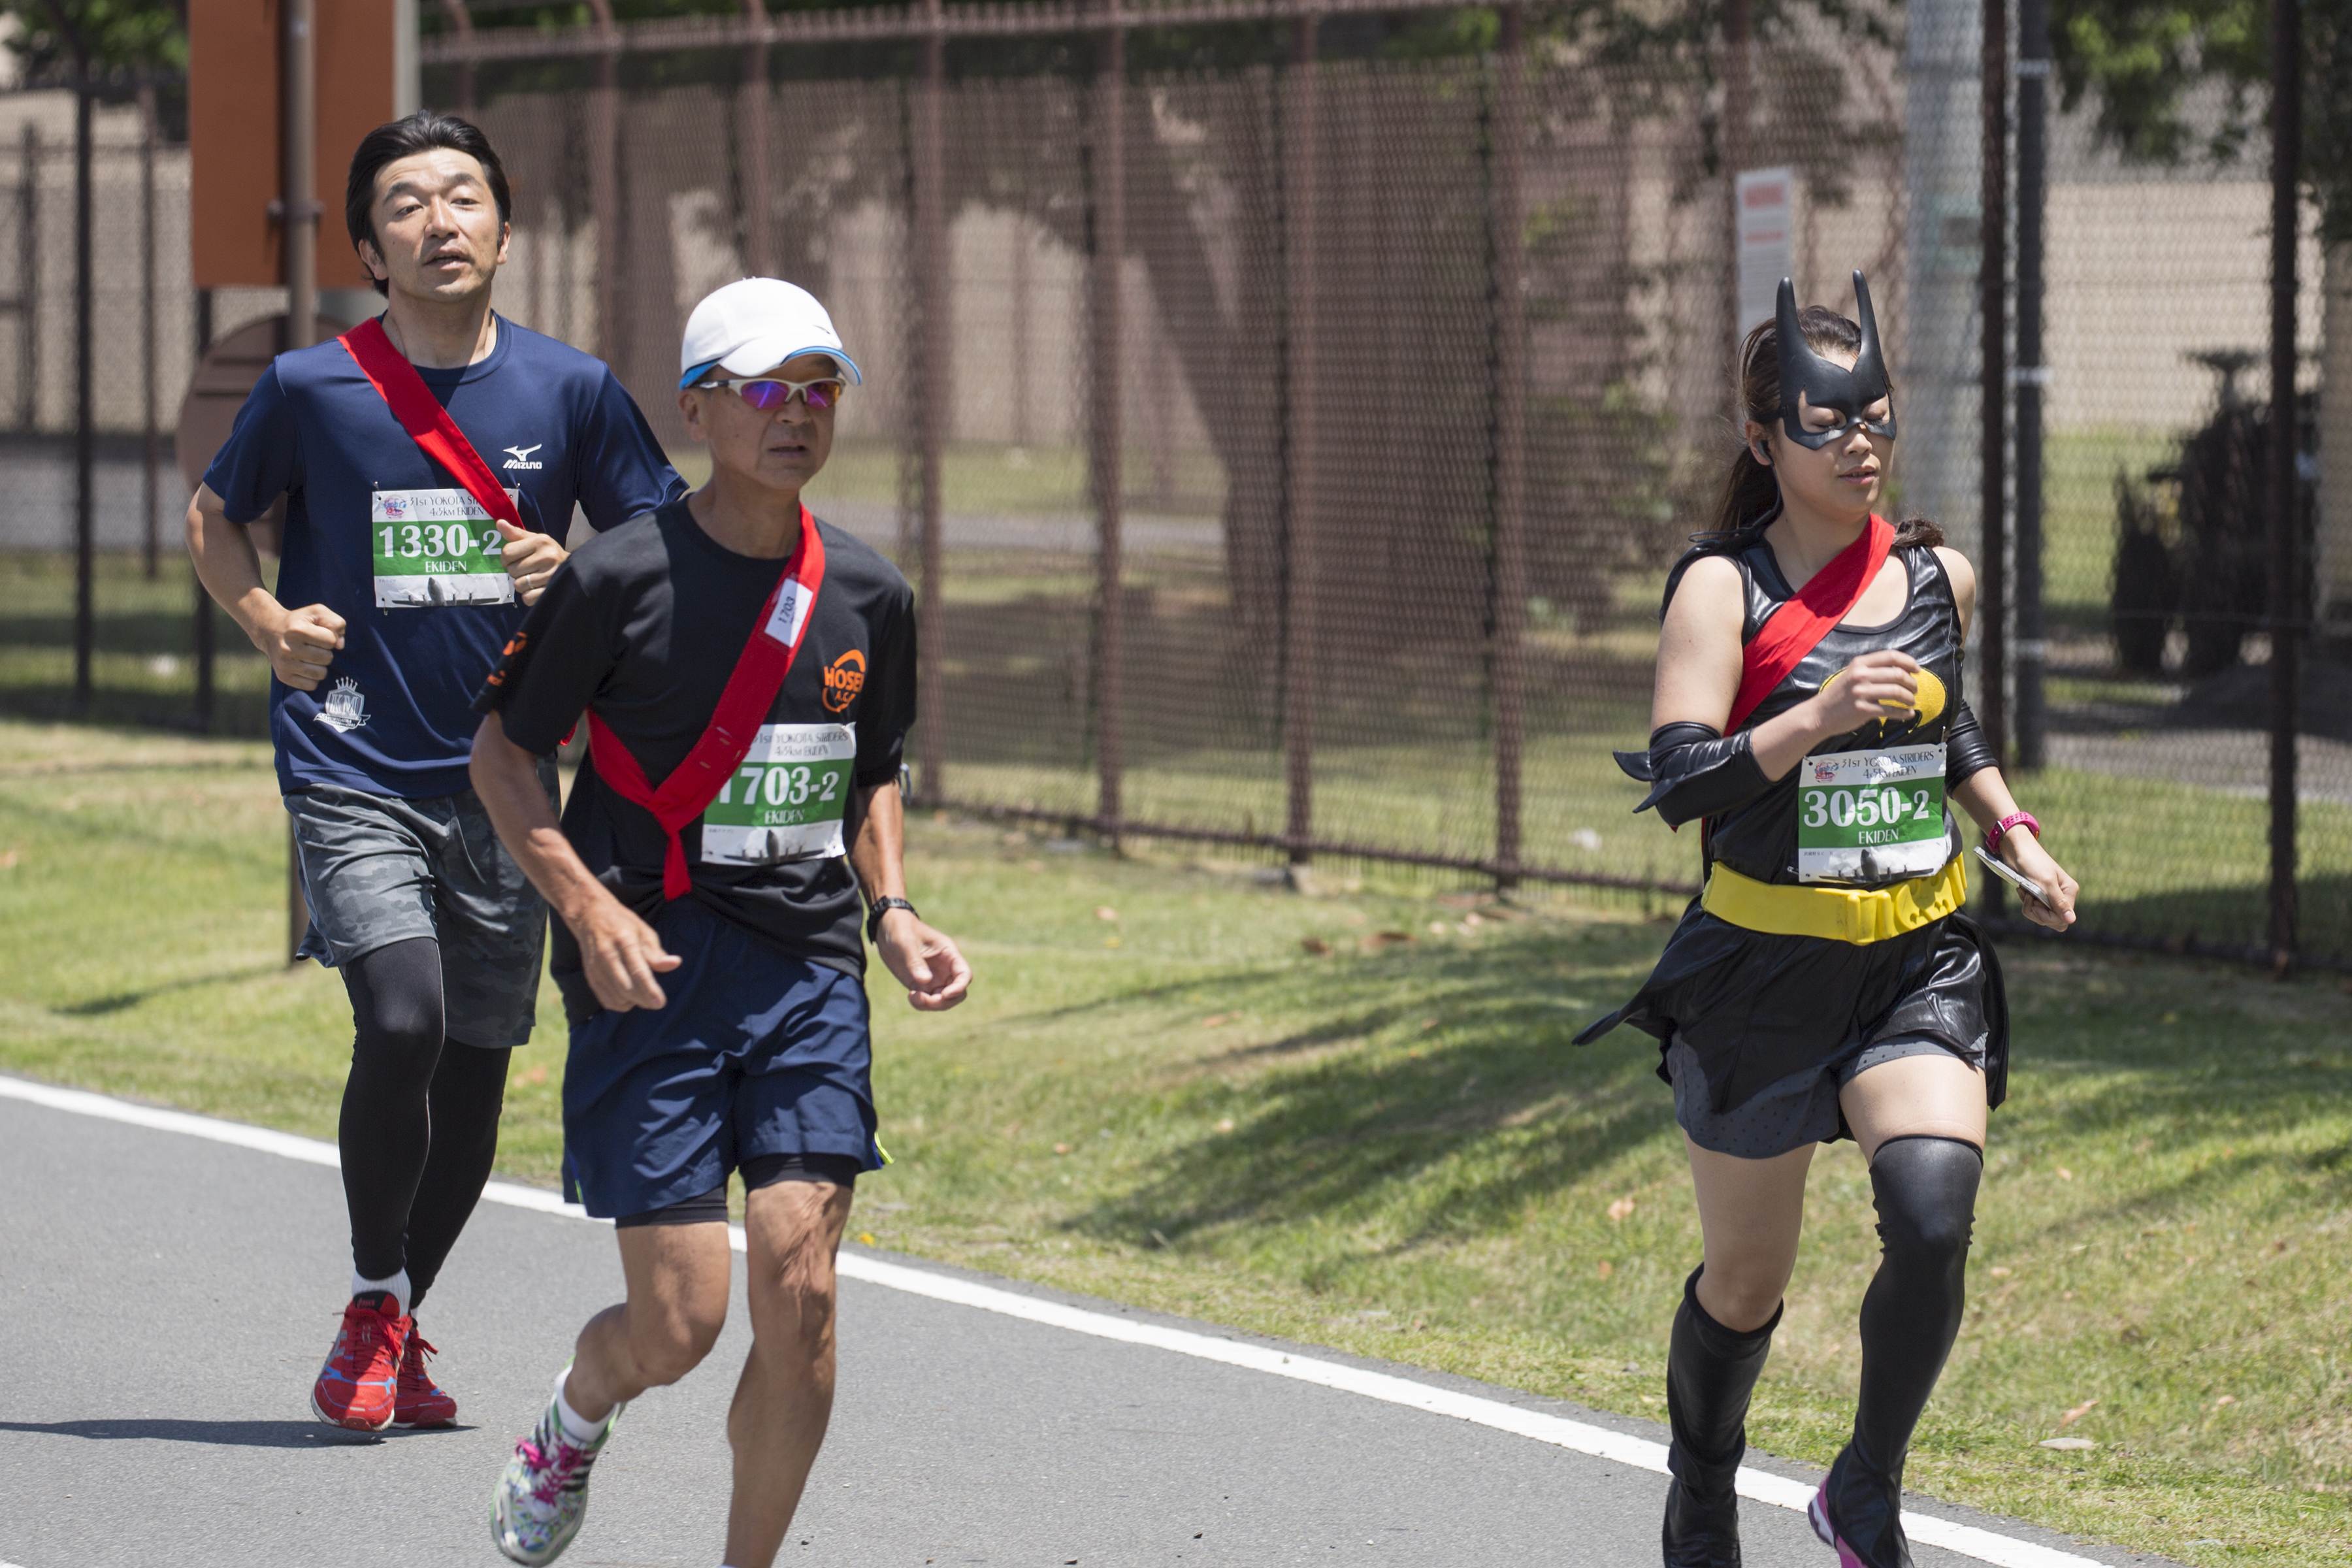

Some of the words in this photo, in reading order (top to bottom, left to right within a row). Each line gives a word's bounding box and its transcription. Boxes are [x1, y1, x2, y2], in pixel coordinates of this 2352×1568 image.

[430, 496, 465, 506] YOKOTA
[457, 506, 484, 516] EKIDEN
[378, 523, 502, 558] 1330-2
[425, 560, 467, 573] EKIDEN
[777, 596, 795, 624] 1703
[775, 732, 813, 743] YOKOTA
[1864, 756, 1898, 768] YOKOTA
[1899, 751, 1935, 764] STRIDERS
[1892, 764, 1918, 777] EKIDEN
[719, 766, 840, 806] 1703-2
[1803, 786, 1929, 828] 3050-2
[764, 808, 805, 825] EKIDEN
[1859, 828, 1899, 844] EKIDEN
